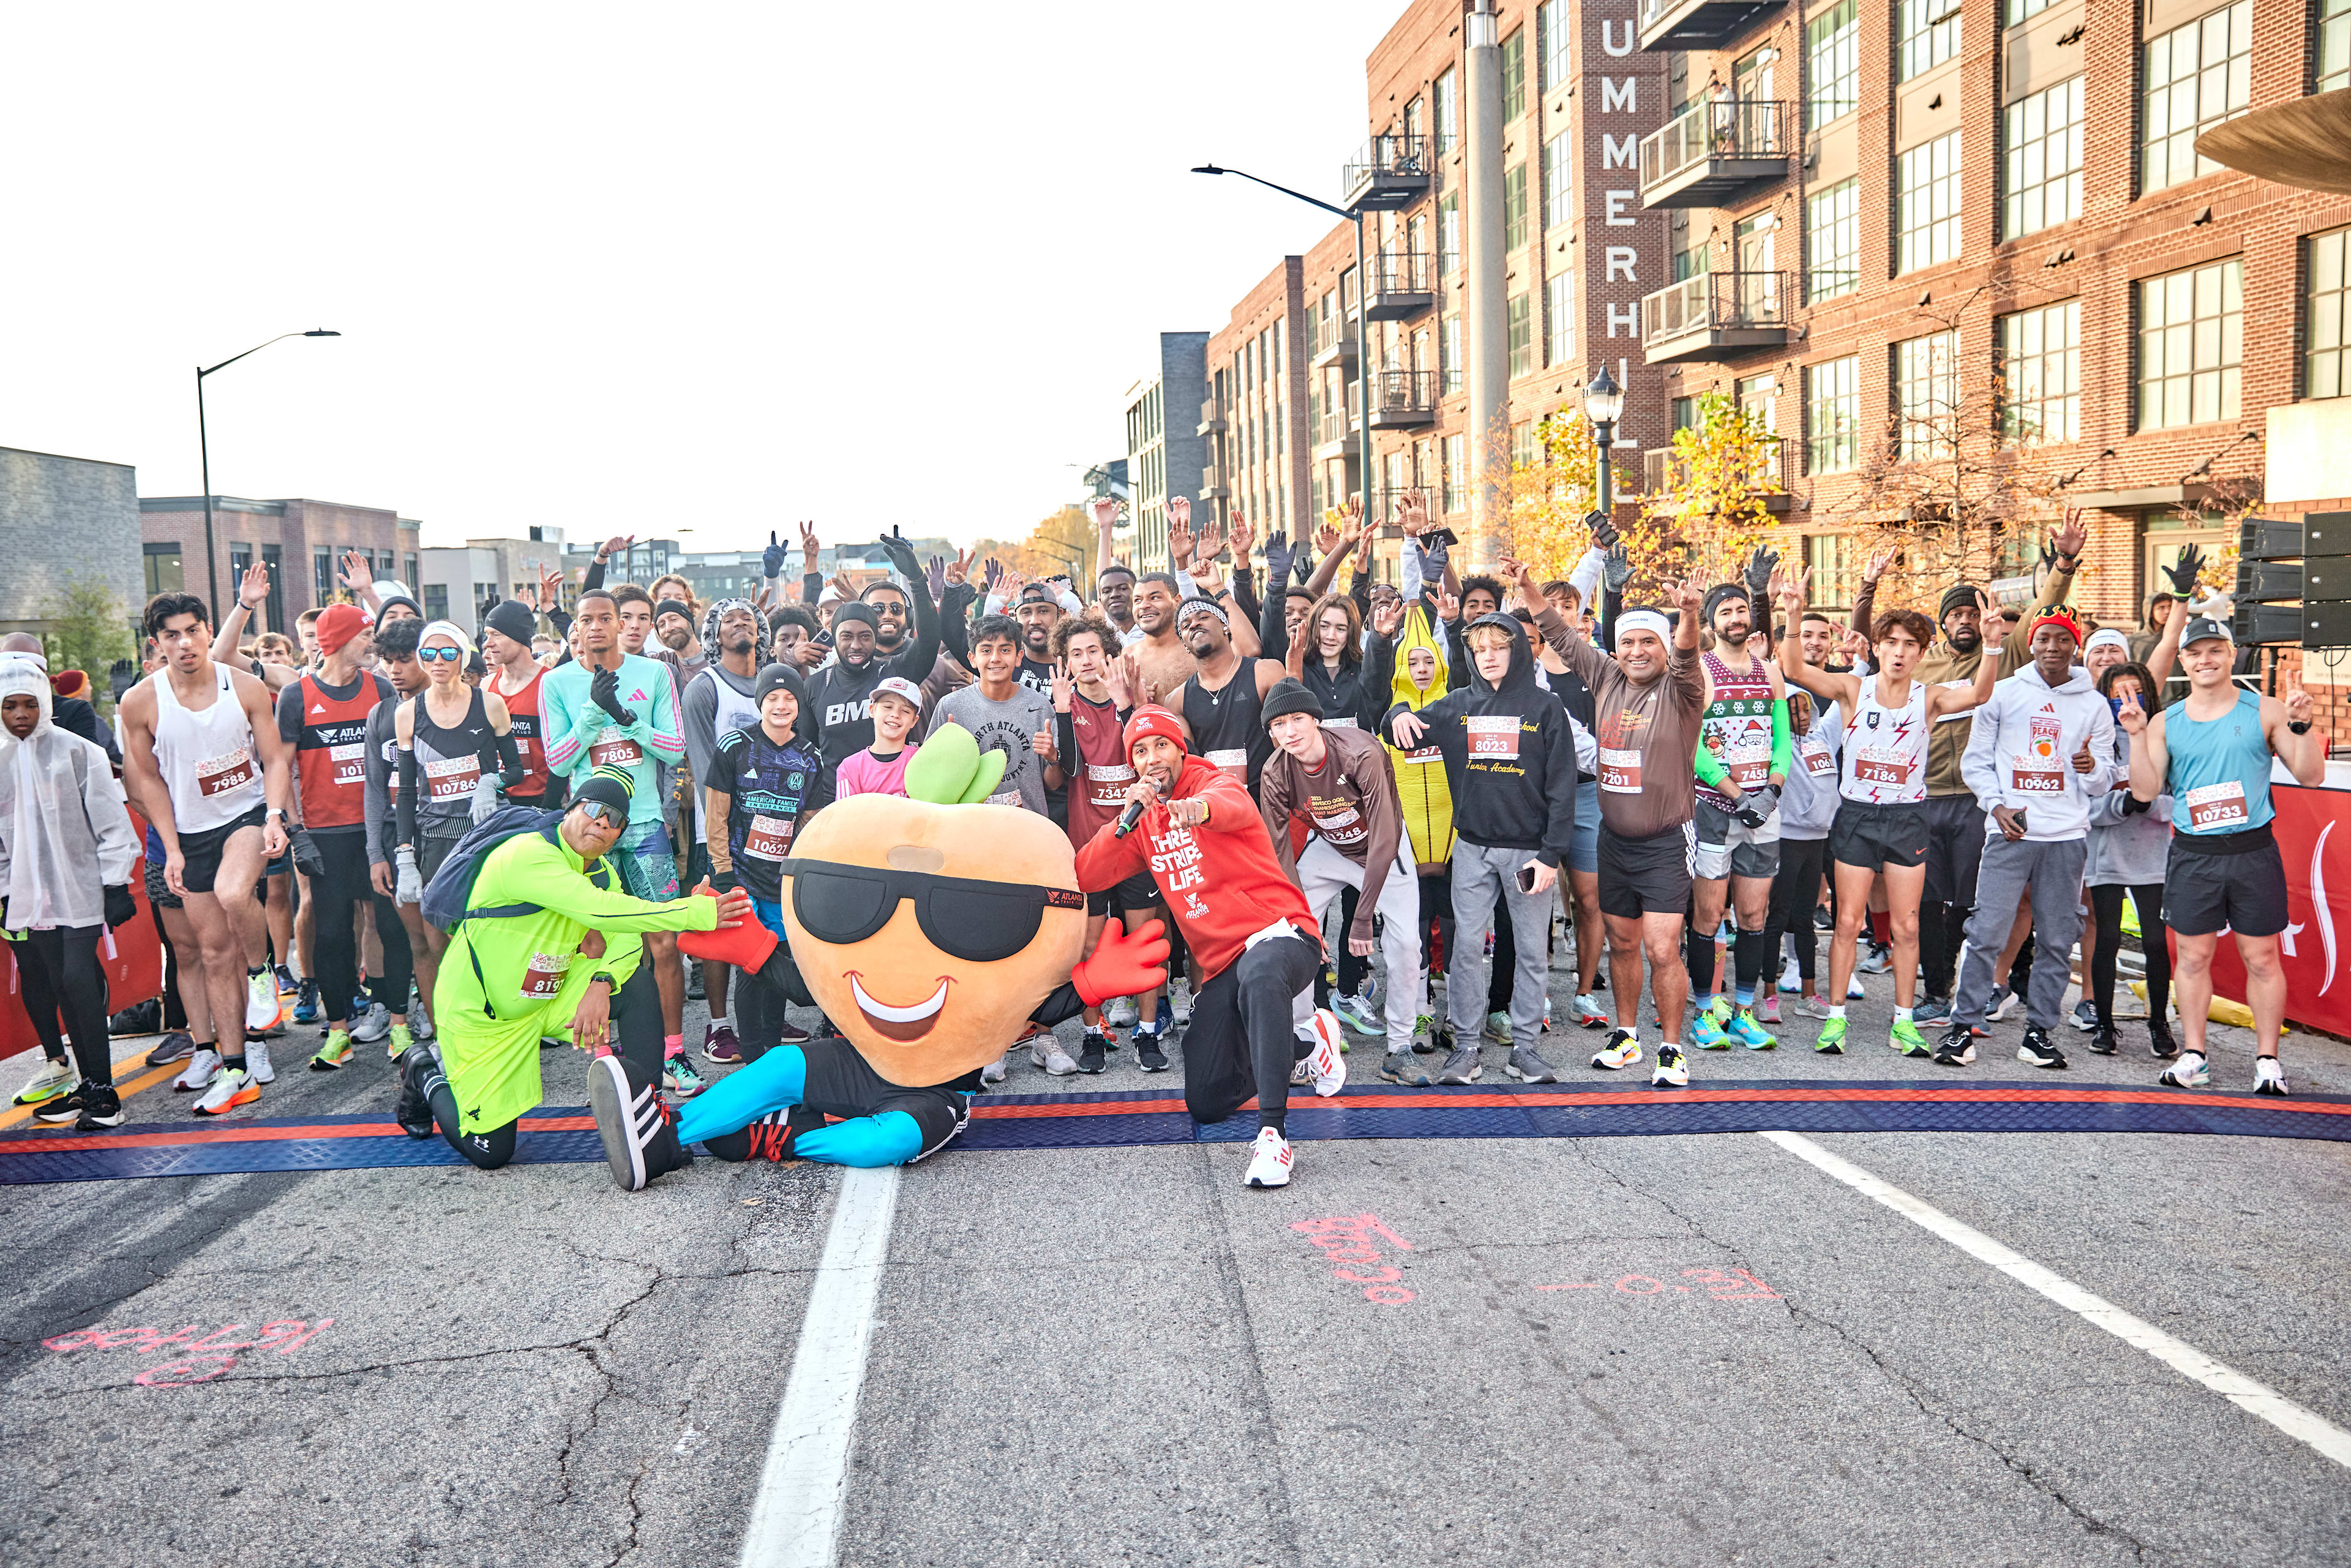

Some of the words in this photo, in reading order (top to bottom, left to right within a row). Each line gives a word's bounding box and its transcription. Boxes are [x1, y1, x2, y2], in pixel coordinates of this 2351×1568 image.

[825, 699, 873, 726] BM
[997, 721, 1030, 751] ATLANTA
[2033, 727, 2058, 740] PEACH
[1475, 740, 1508, 752] 8023
[599, 748, 634, 764] 7805
[1602, 771, 1629, 786] 7201
[1741, 768, 1768, 781] 7458
[1863, 768, 1897, 782] 7186
[212, 772, 246, 792] 7988
[435, 779, 477, 795] 10786
[2017, 778, 2059, 790] 10962
[746, 795, 776, 804] AMERICAN
[1098, 787, 1128, 799] 7342
[749, 803, 793, 811] INSURANCE
[1313, 802, 1348, 811] THANKSGIVING
[2195, 805, 2241, 823] 10733
[754, 838, 788, 855] 10627
[1169, 865, 1204, 891] LIFE
[1061, 892, 1083, 902] ATLANTA
[1186, 904, 1209, 917] ATLANTA
[534, 978, 565, 992] 8197
